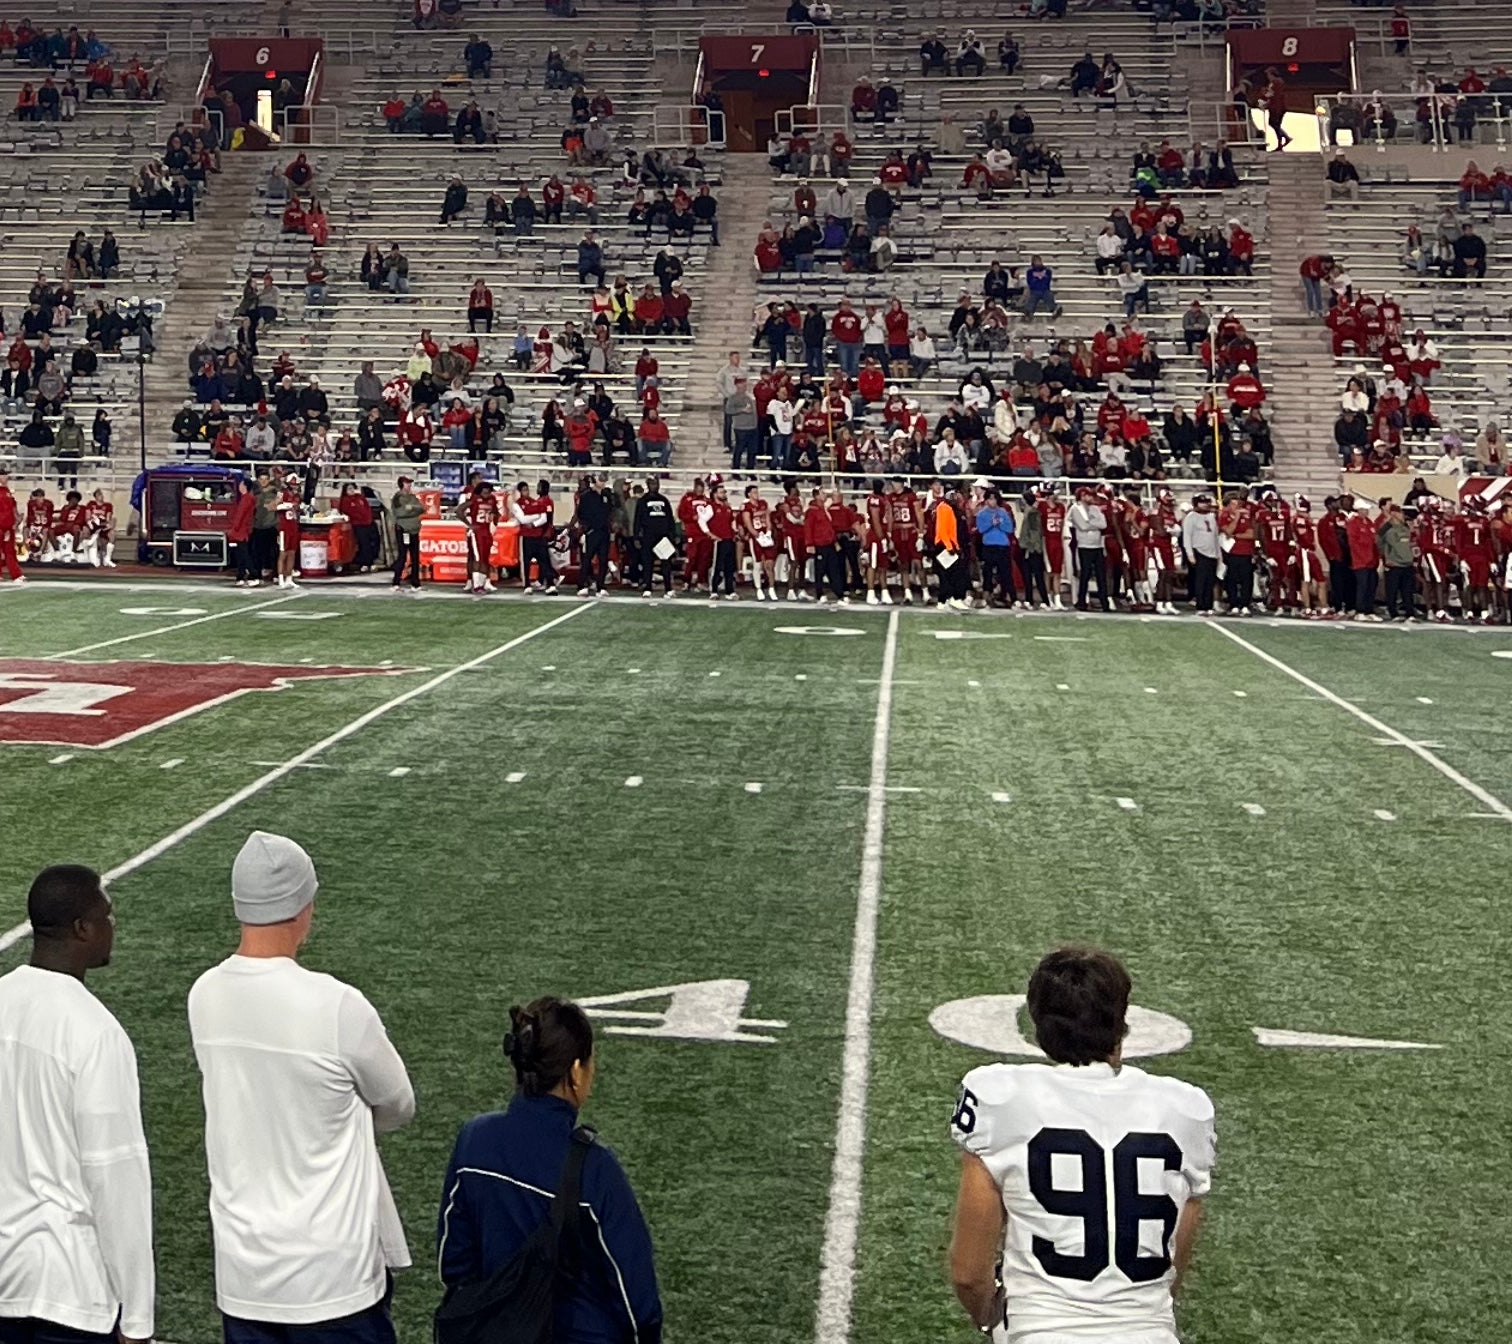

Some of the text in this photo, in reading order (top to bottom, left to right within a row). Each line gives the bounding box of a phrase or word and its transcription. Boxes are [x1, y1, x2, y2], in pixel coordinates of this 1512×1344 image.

[256, 46, 270, 64] 6
[751, 44, 765, 63] 7
[1282, 36, 1298, 57] 8
[951, 1088, 979, 1134] 6
[1027, 1126, 1183, 1283] 96
